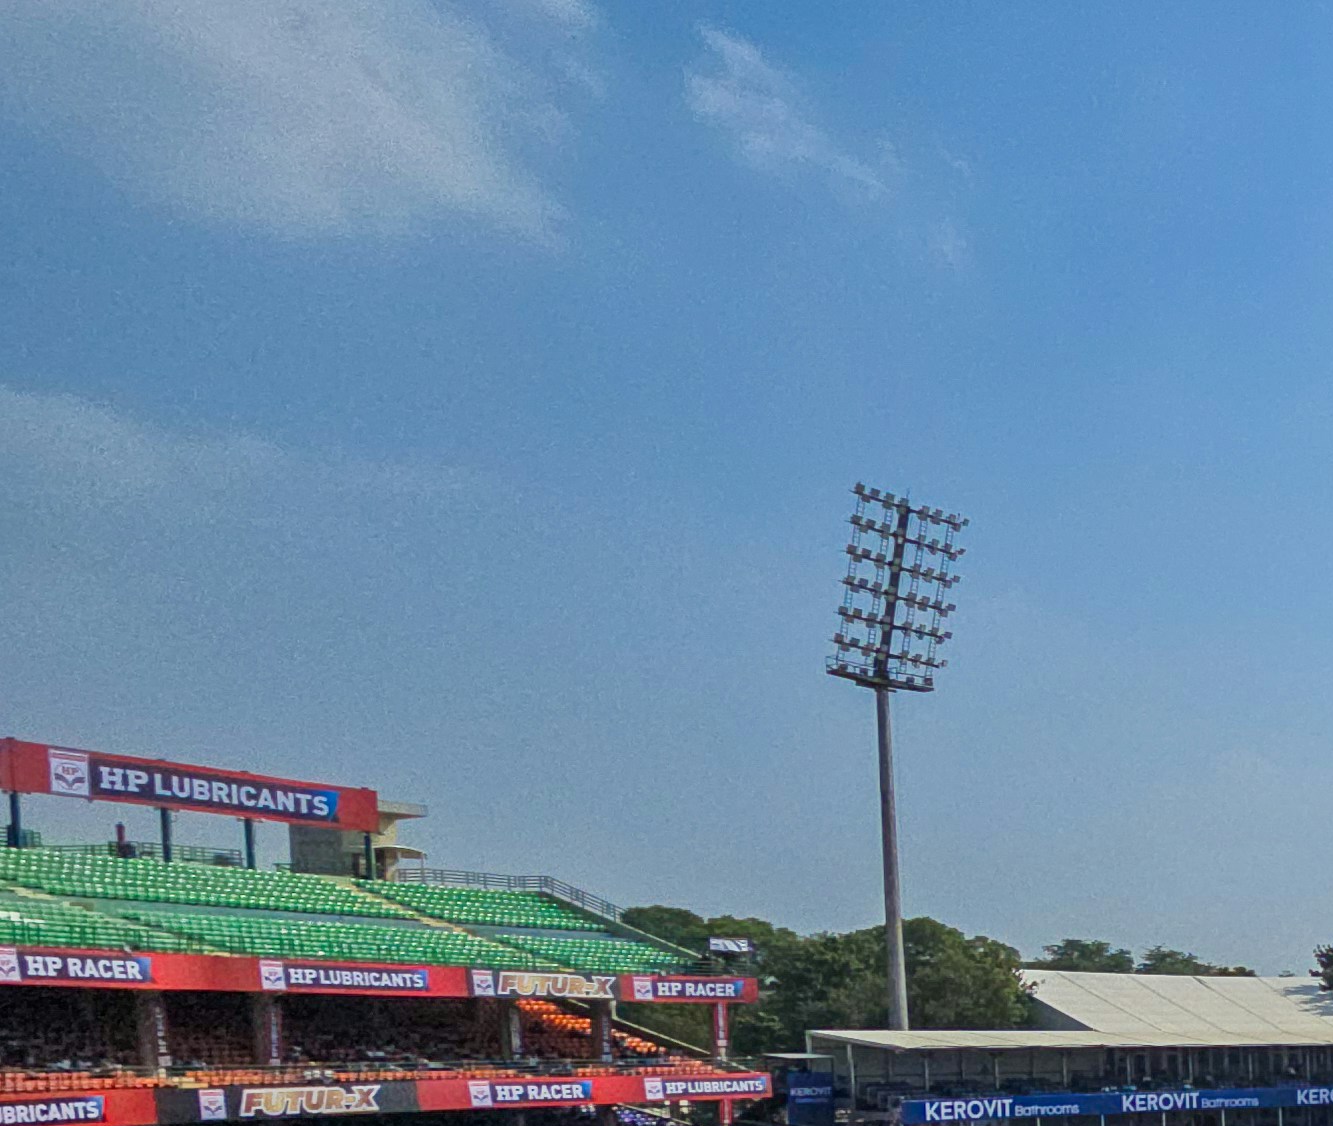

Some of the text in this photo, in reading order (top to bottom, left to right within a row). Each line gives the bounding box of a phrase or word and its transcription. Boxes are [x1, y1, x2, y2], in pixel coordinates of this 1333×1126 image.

[99, 766, 331, 817] HP LUBRICANTS
[24, 955, 143, 980] HP RACER
[288, 968, 424, 988] HP LUBRICANTS
[498, 971, 616, 998] FUTUR-X
[657, 981, 735, 998] HP RACER
[496, 1084, 584, 1101] HP RACER
[665, 1080, 764, 1094] HP LUBRICANTS
[240, 1085, 381, 1118] FUTUR-X
[925, 1099, 1080, 1121] KEROVIT Bathrooms
[1122, 1092, 1259, 1112] KEROVIT Bathrooms
